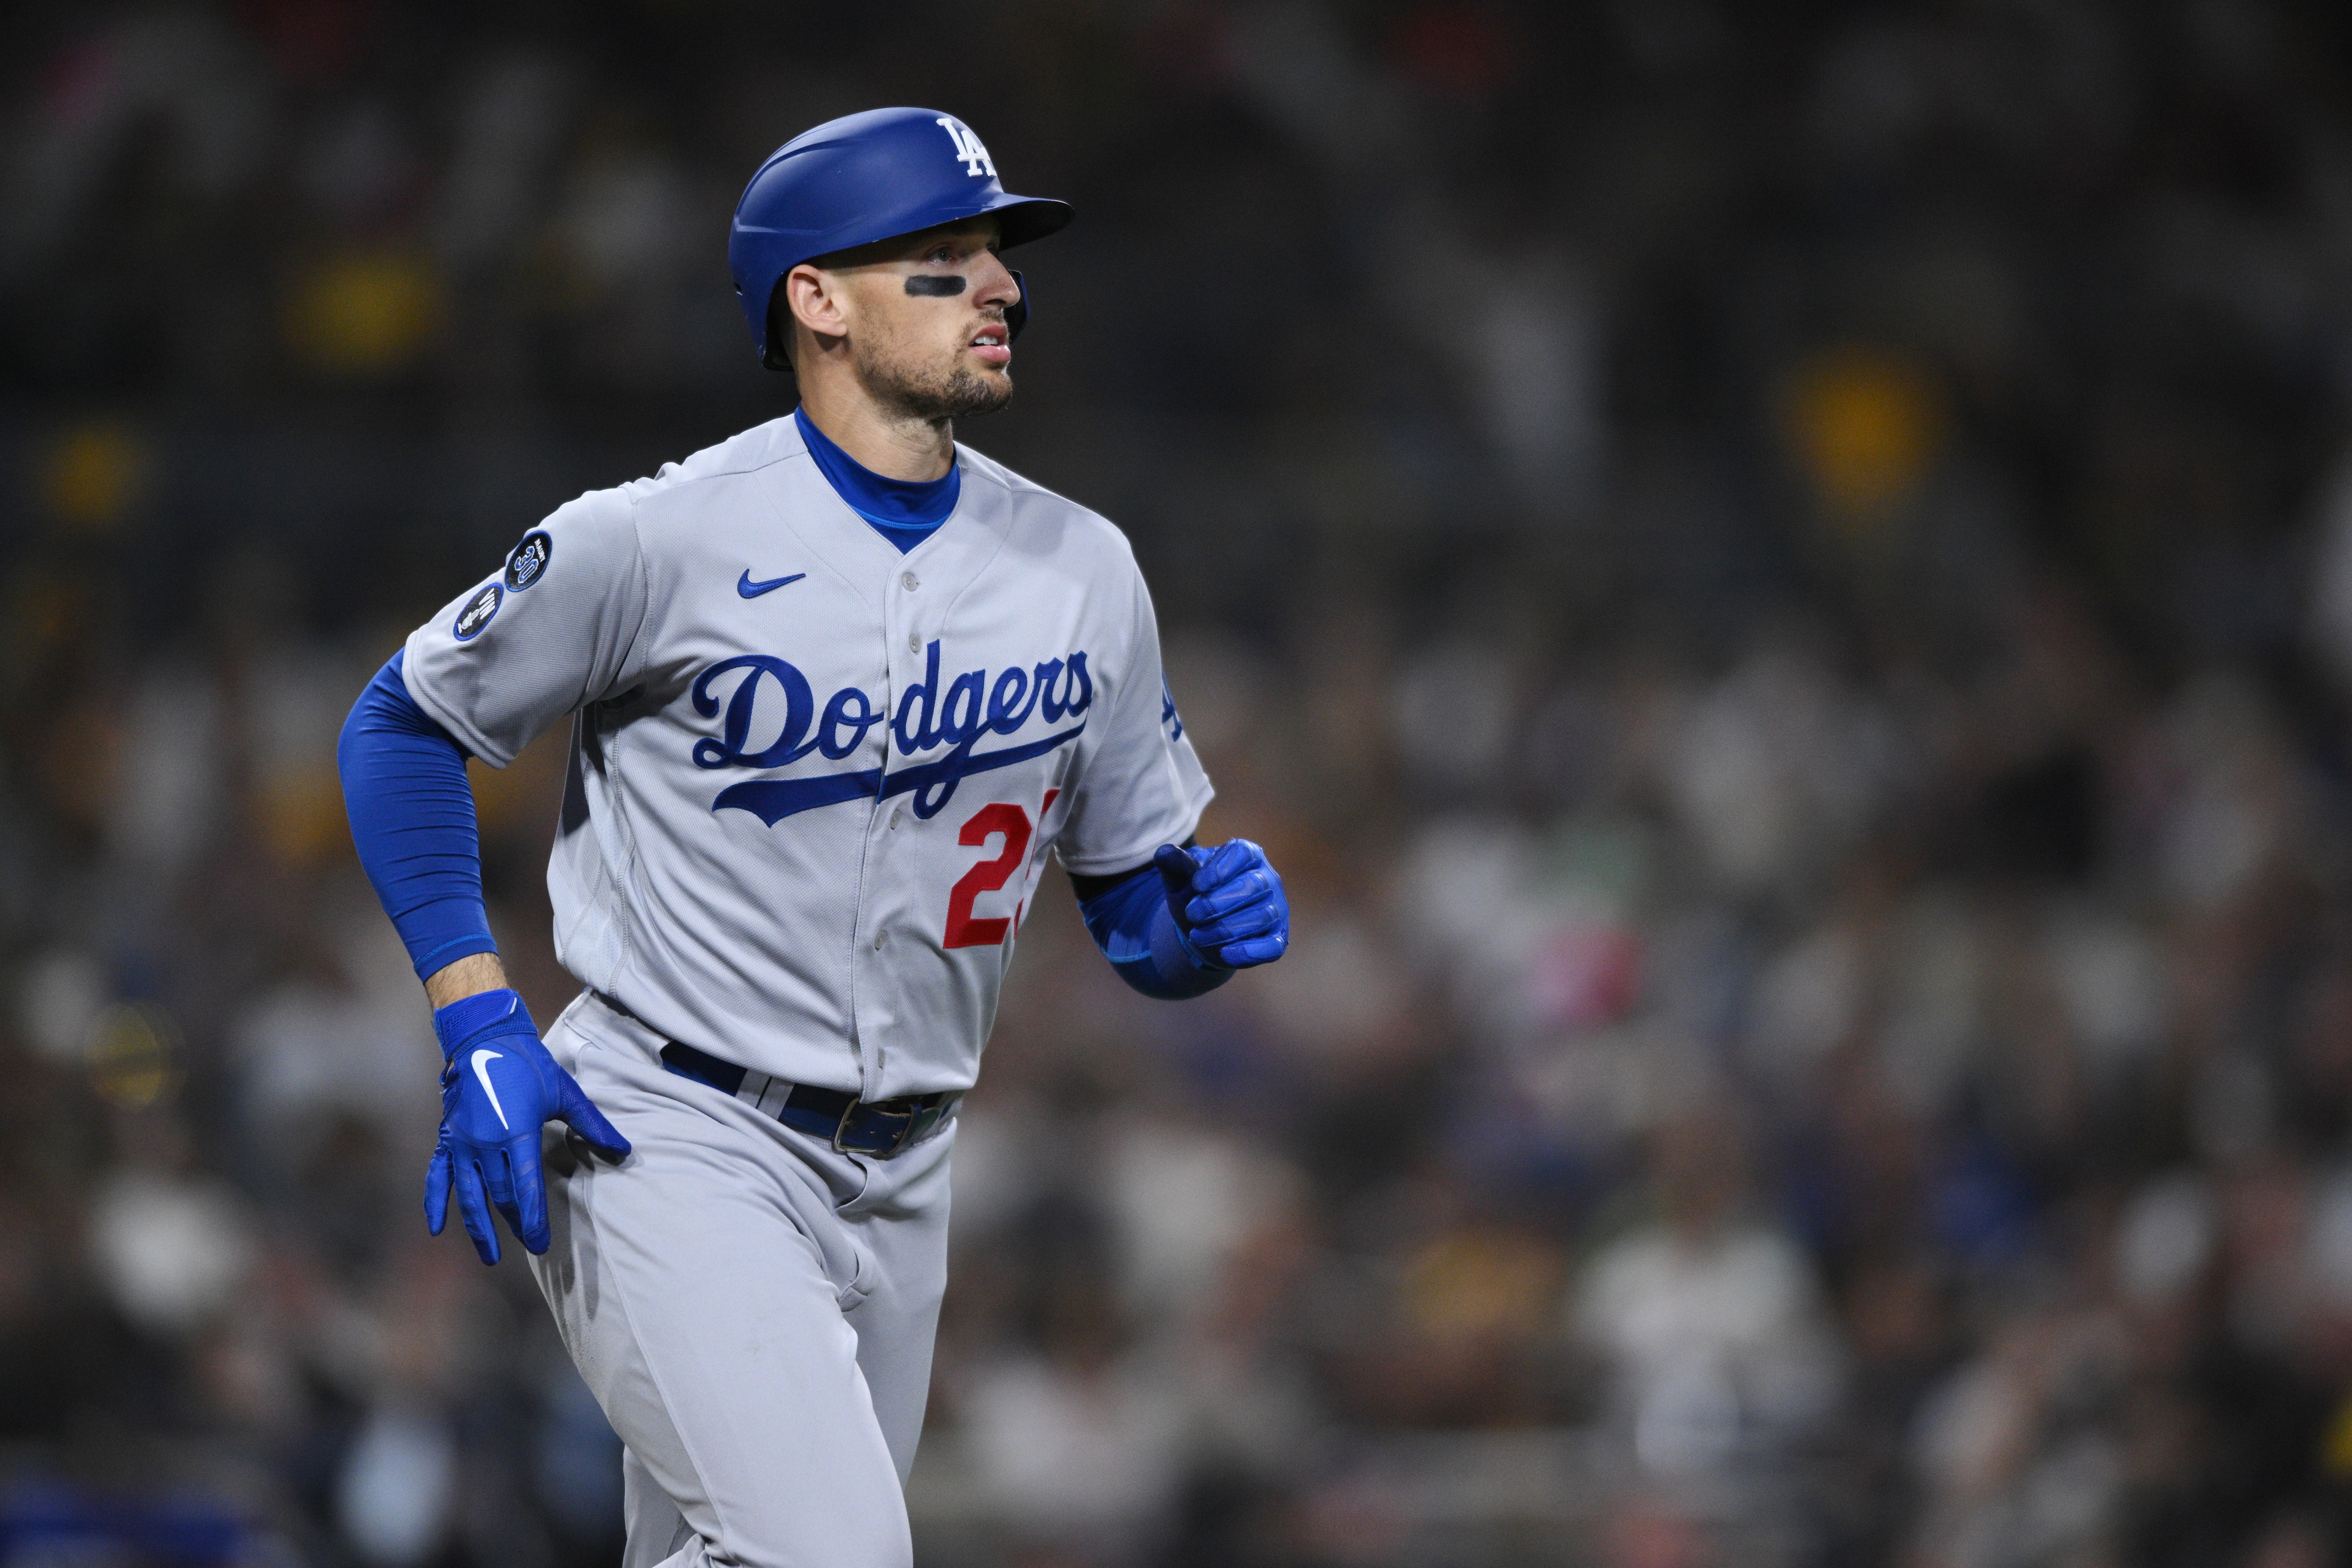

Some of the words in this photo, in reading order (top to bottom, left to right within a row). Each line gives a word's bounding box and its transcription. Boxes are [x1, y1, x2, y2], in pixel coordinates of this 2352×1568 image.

[936, 118, 997, 177] LA
[514, 546, 539, 583] 30
[534, 538, 546, 562] MAURY
[479, 587, 495, 619] VIN
[693, 639, 1092, 819] Dodgers
[943, 789, 1061, 949] 2
